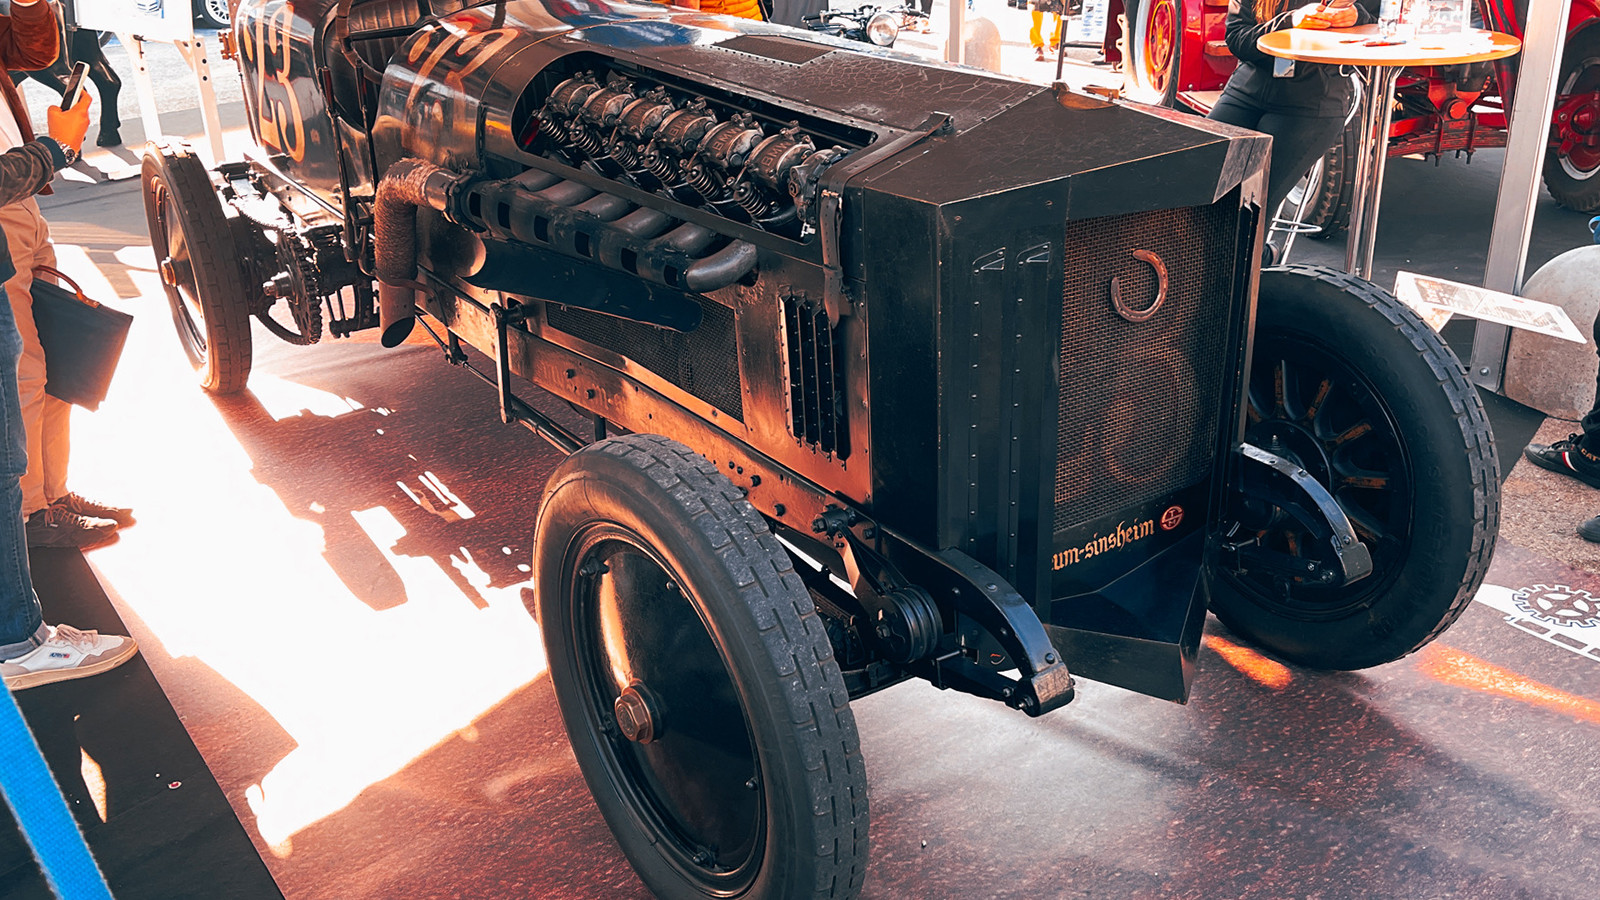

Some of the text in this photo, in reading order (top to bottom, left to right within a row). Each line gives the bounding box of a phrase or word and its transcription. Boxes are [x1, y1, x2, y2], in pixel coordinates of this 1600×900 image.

[668, 114, 696, 137] BMW
[712, 127, 742, 151] BMW
[762, 141, 792, 166] BMW
[1051, 517, 1155, 571] um-sinsheim
